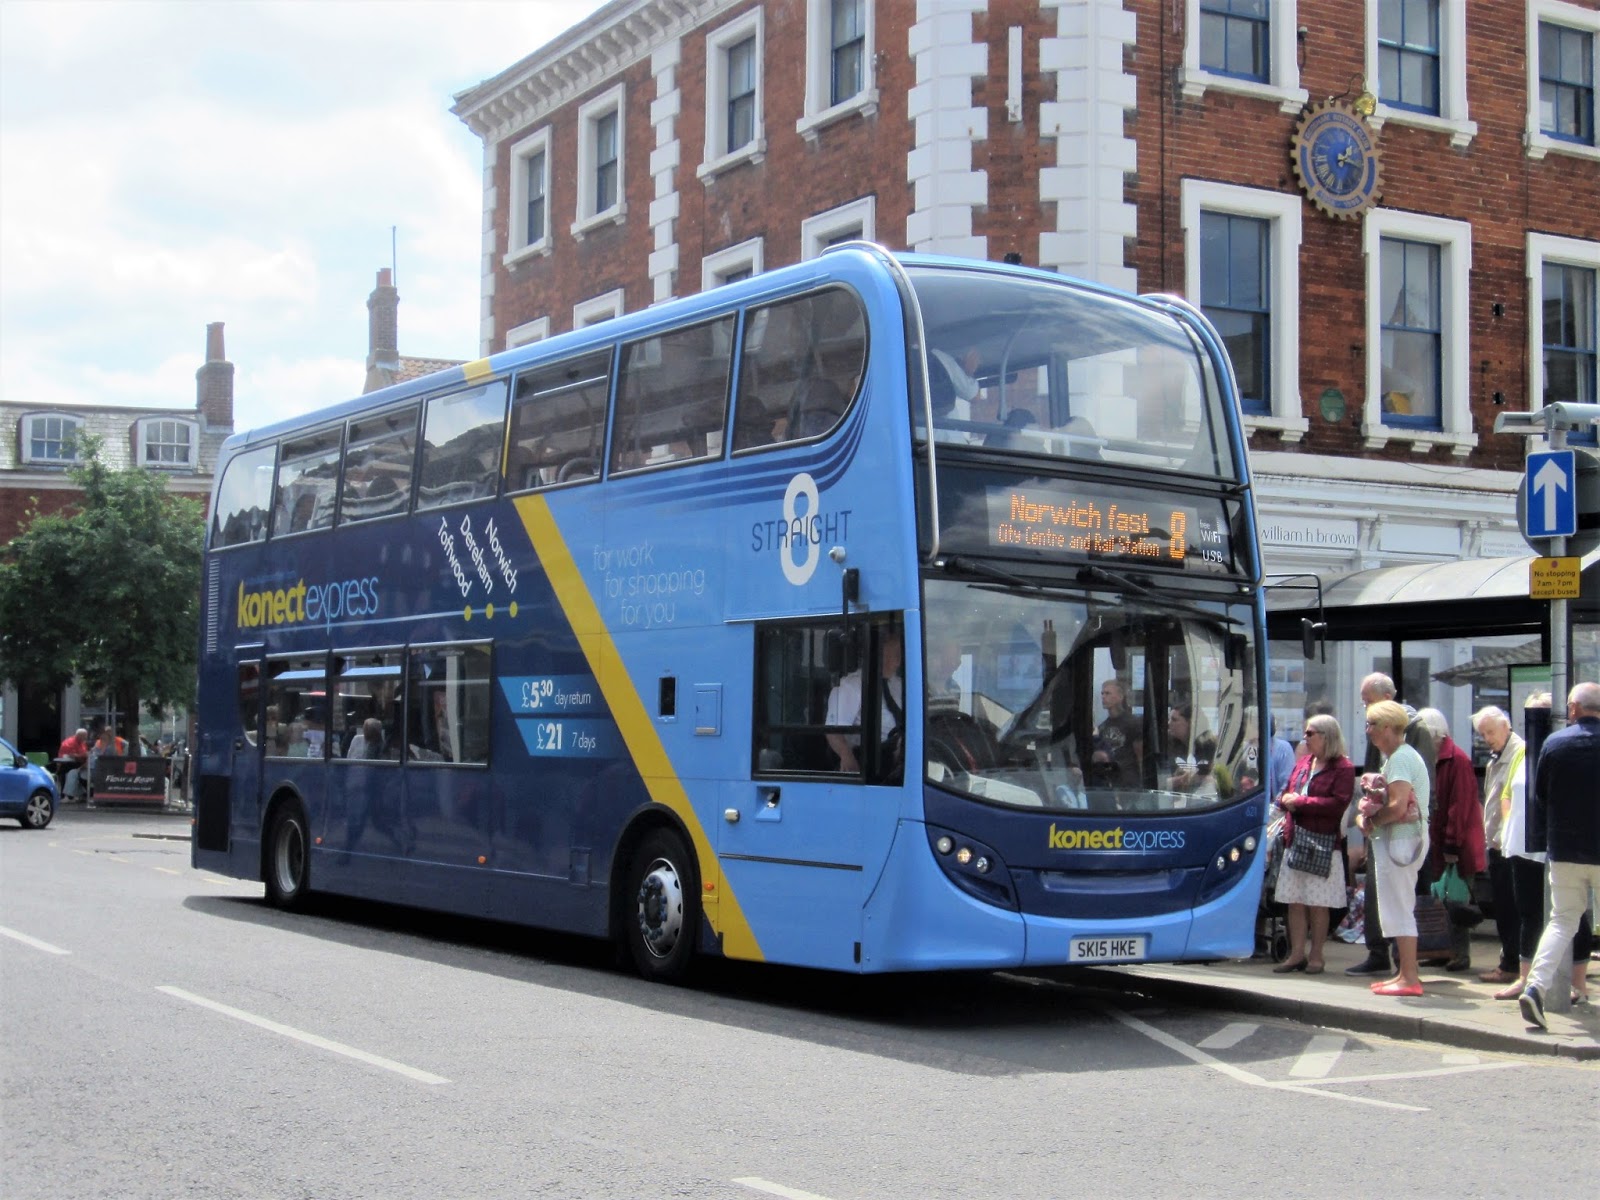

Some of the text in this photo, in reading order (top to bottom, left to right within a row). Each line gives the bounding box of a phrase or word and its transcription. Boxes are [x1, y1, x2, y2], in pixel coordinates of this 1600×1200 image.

[752, 510, 852, 552] STRAIGHT
[780, 472, 820, 586] 8
[1011, 494, 1149, 534] Norwich fast
[998, 523, 1160, 557] City Centre and Rail Station
[1169, 511, 1186, 559] 8
[1200, 530, 1221, 544] WiFi
[1260, 525, 1356, 545] william h brown
[438, 516, 473, 597] Toftwood
[460, 514, 493, 594] Dereham
[485, 517, 517, 593] Norwich
[593, 537, 655, 572] for work
[1202, 549, 1223, 563] USB
[605, 564, 705, 598] for shopping
[621, 598, 675, 629] for you
[554, 689, 569, 710] day
[568, 691, 591, 705] return
[536, 723, 596, 752] £21 7 days
[1077, 940, 1137, 958] SK15 HKE
